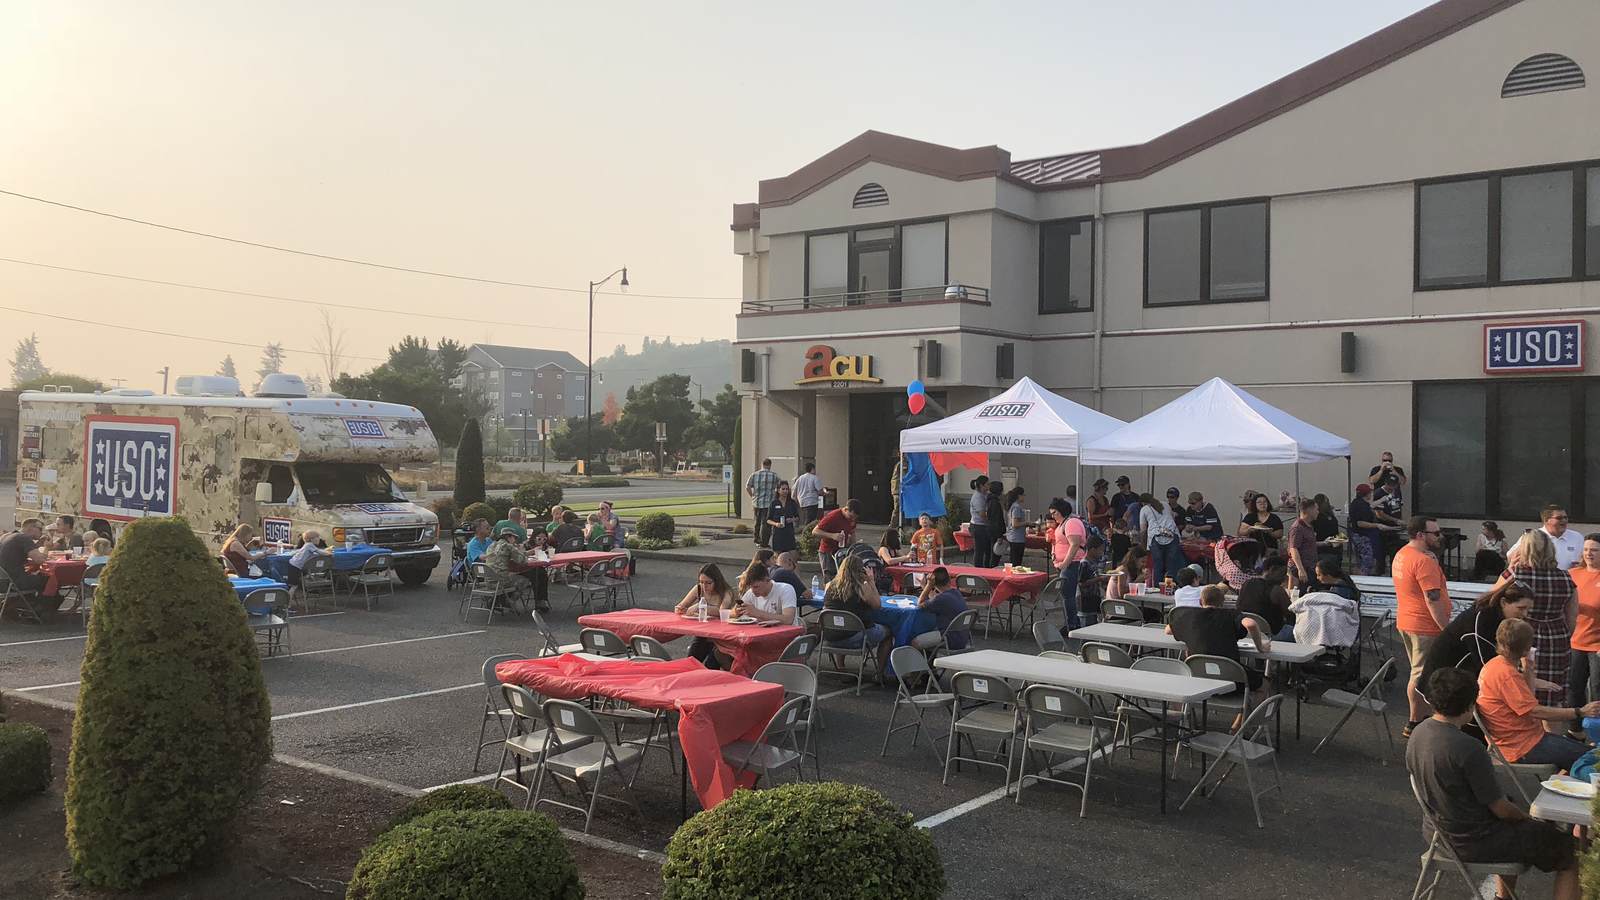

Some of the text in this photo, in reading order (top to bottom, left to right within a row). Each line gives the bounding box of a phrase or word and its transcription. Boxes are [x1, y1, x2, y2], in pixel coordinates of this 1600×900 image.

[1505, 330, 1560, 362] USO
[804, 345, 870, 379] acu
[987, 404, 1021, 417] USO
[352, 421, 377, 435] USO
[940, 434, 1031, 448] www.USONW.org
[104, 439, 156, 500] USO
[269, 523, 285, 540] USO
